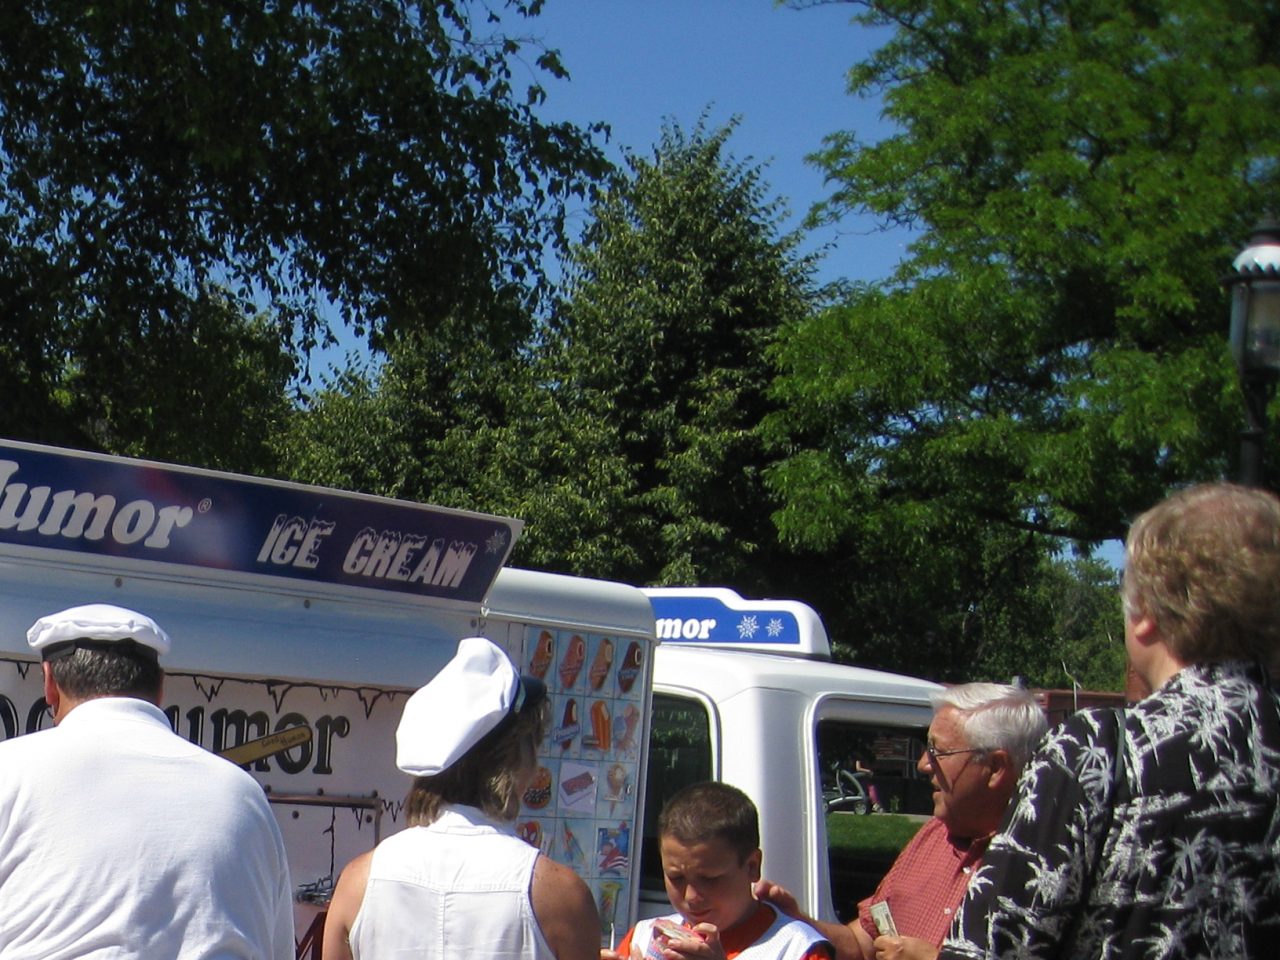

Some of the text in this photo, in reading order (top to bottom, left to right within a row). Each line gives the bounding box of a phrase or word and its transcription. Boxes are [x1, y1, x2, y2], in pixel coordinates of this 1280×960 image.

[257, 513, 478, 588] ICE CREAM
[656, 617, 717, 640] mor
[164, 704, 351, 775] umor
